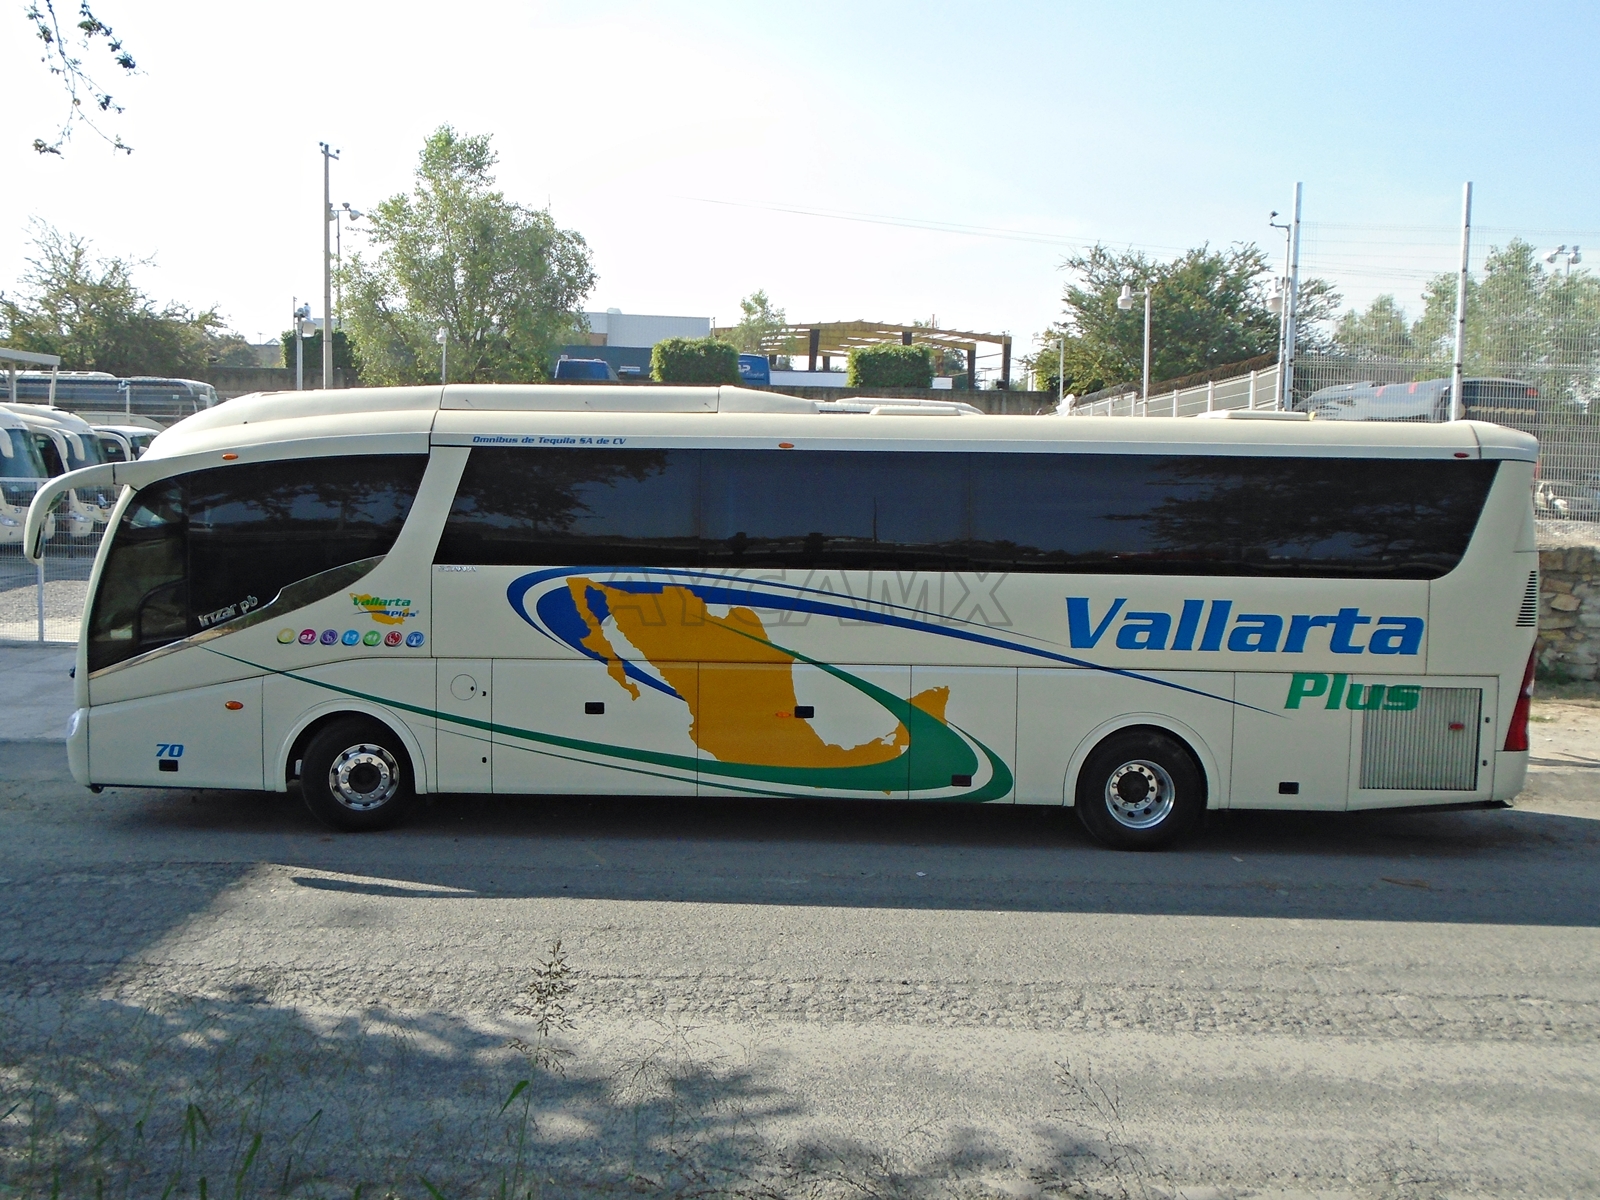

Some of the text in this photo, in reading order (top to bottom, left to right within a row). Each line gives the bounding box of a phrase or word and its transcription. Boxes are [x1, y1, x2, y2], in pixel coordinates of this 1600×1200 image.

[472, 436, 627, 445] Omnibus de Tequila SA de CV
[239, 594, 258, 615] pb
[353, 596, 411, 607] Vallarta
[1065, 597, 1425, 656] Vallarta
[1284, 673, 1422, 712] Plus
[155, 743, 184, 758] 70
